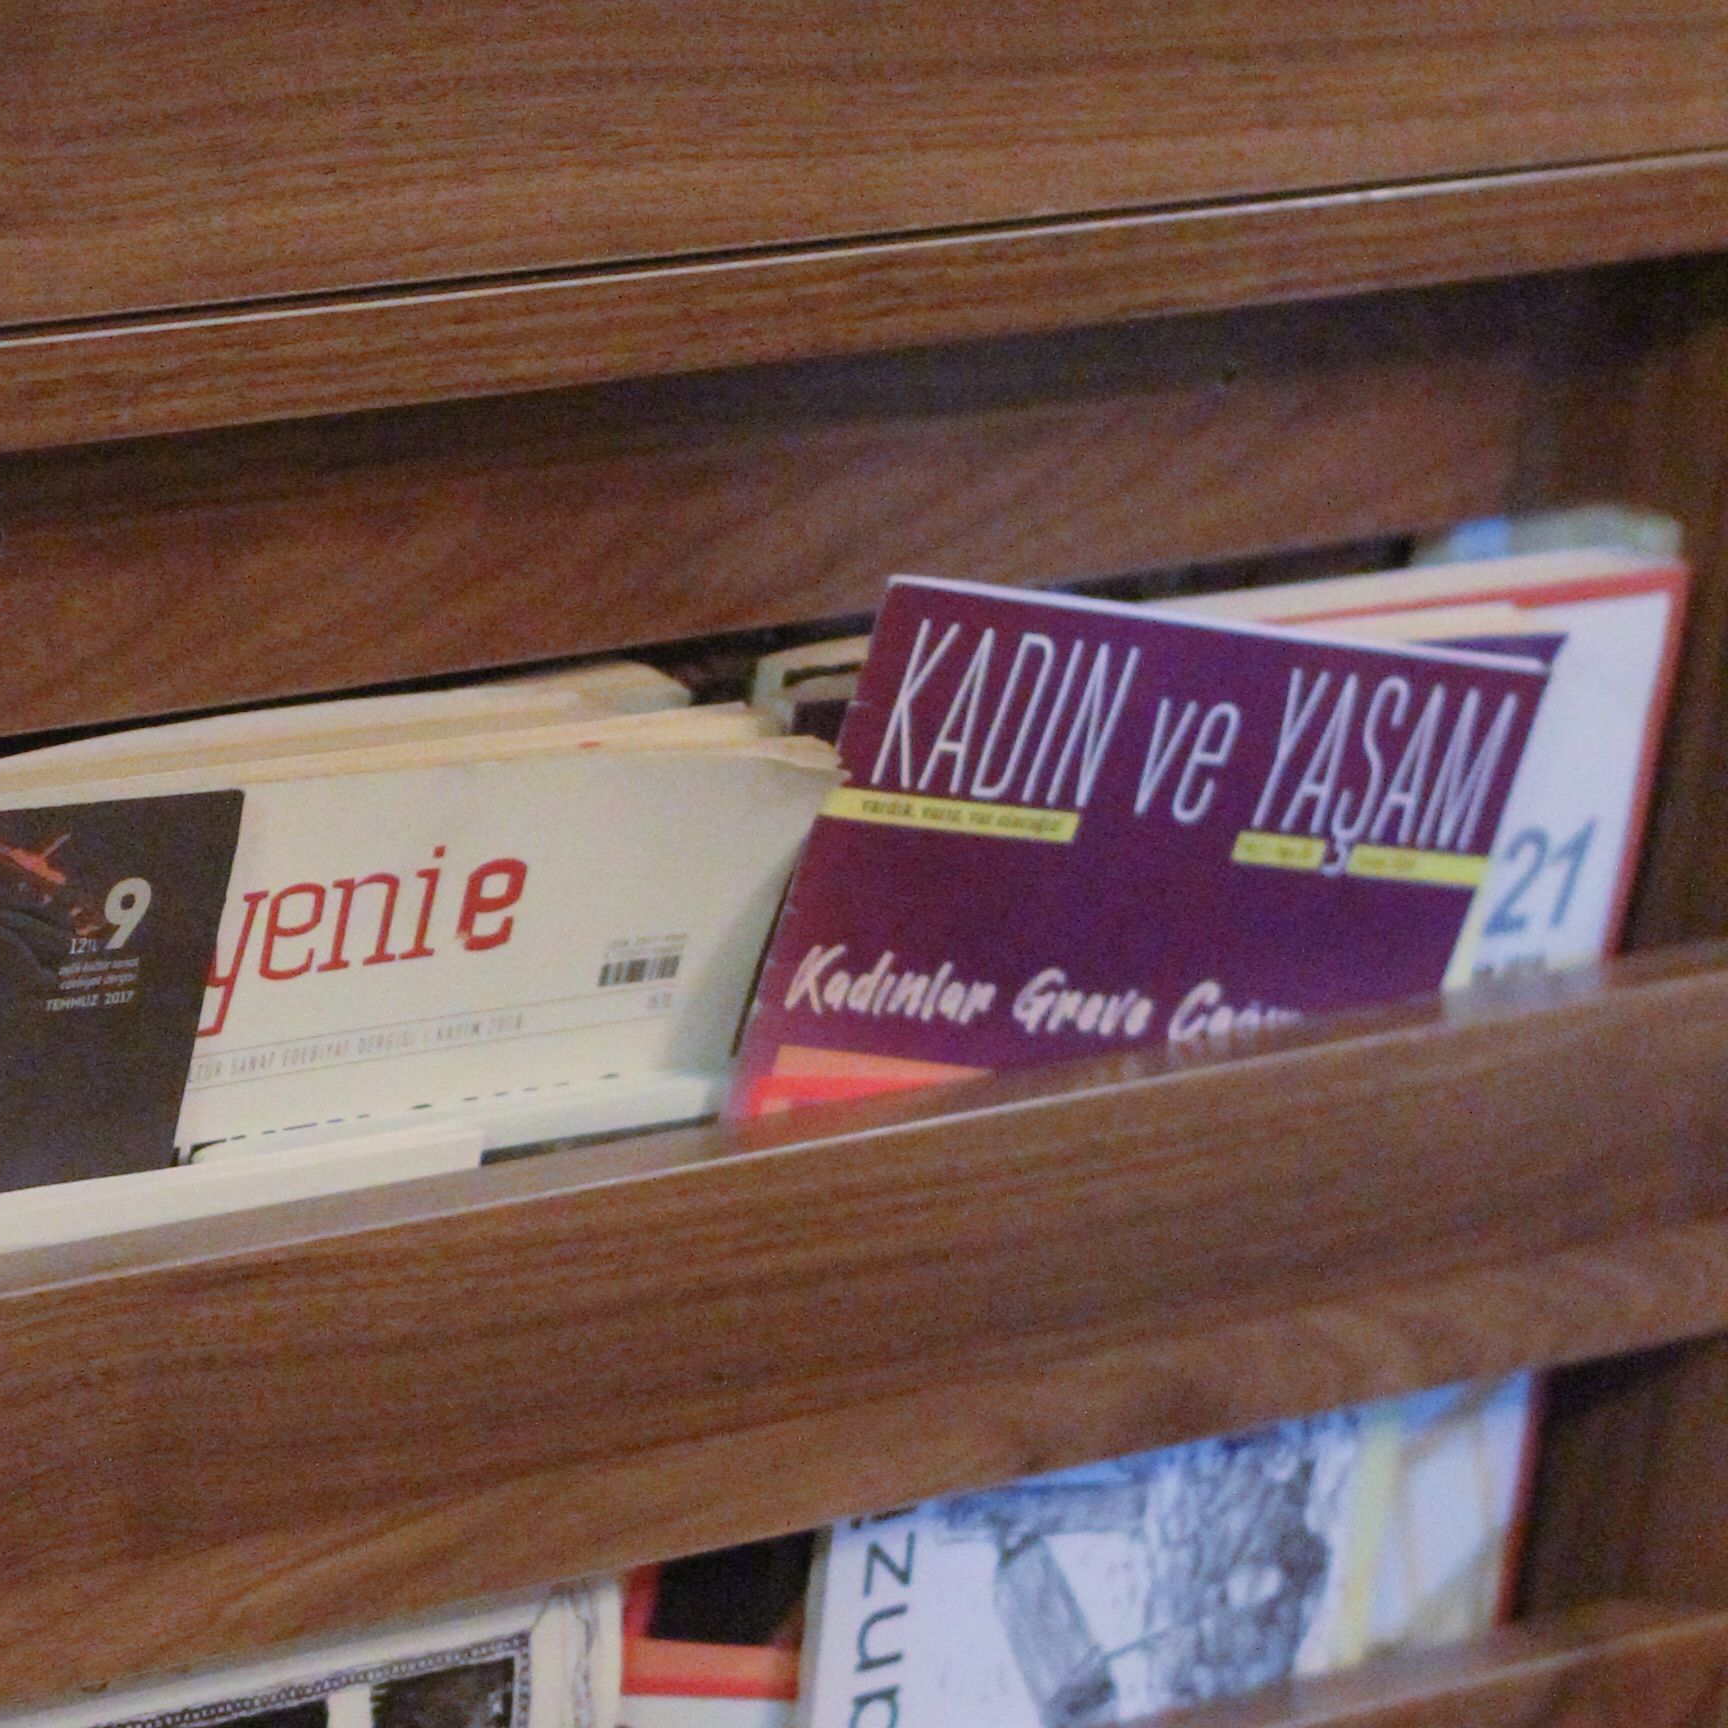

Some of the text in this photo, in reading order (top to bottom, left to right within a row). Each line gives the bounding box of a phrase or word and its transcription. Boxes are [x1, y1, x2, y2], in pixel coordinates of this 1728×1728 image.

[871, 617, 1520, 878] KADIN ve YAŞAM
[104, 876, 152, 950] 9
[1484, 816, 1598, 941] 21
